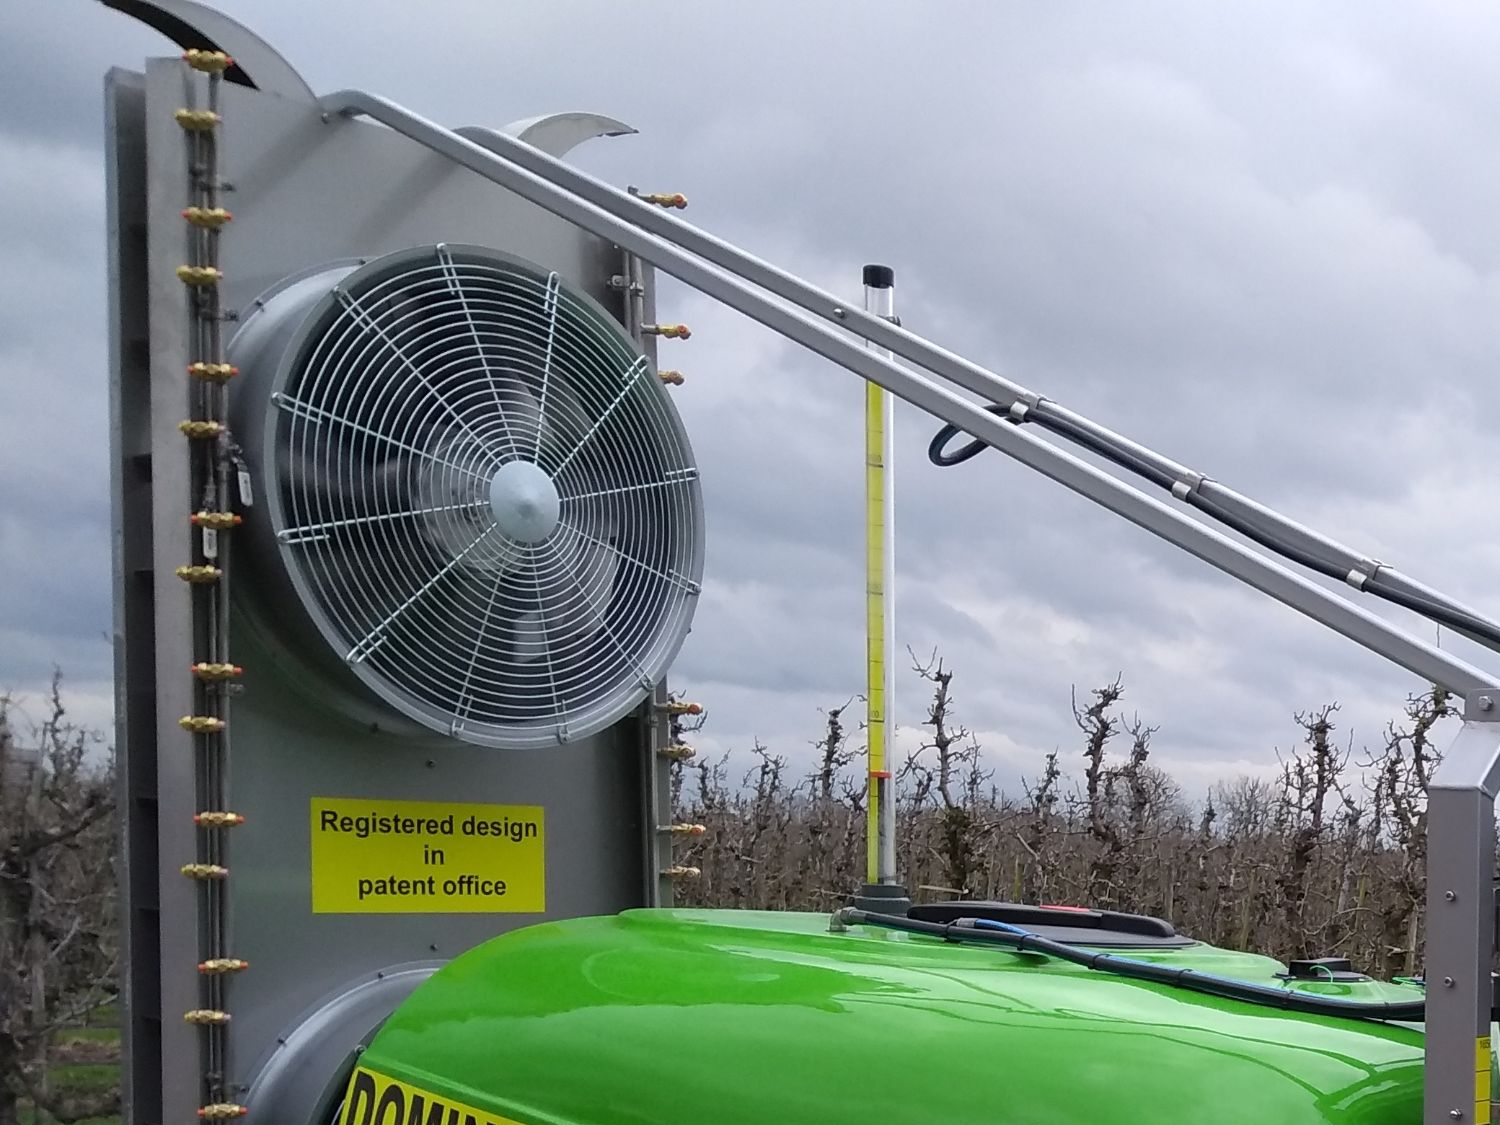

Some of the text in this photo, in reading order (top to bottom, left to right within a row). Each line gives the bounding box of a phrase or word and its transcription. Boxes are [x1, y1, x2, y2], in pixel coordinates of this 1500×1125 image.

[320, 810, 538, 843] Registered design
[424, 844, 445, 866] in
[358, 875, 507, 900] patent office
